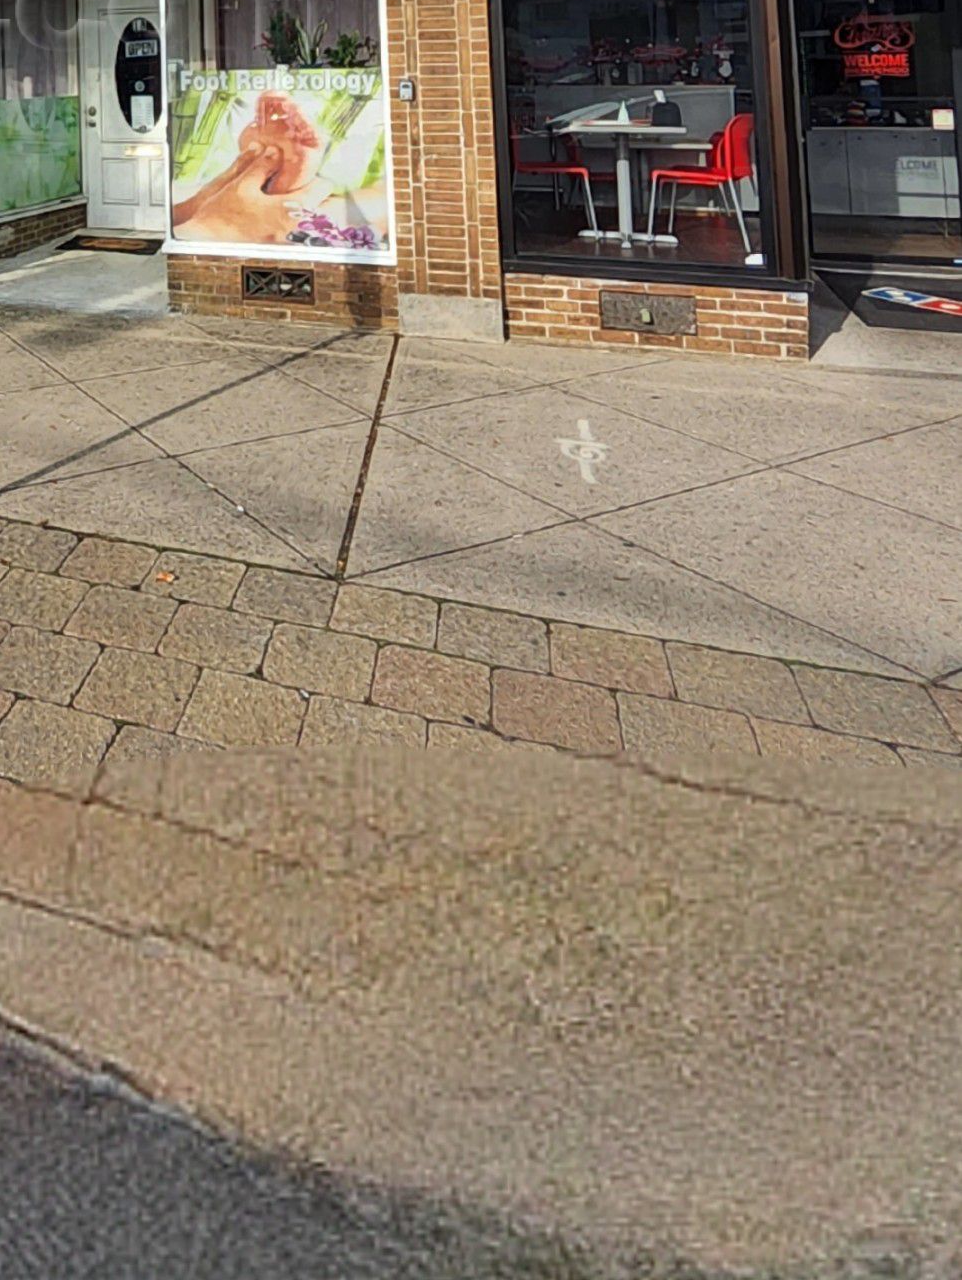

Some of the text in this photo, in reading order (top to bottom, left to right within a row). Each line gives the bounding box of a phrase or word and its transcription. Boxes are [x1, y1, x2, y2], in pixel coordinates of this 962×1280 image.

[844, 53, 909, 67] WELCOME
[180, 69, 376, 96] Foot Reflexology
